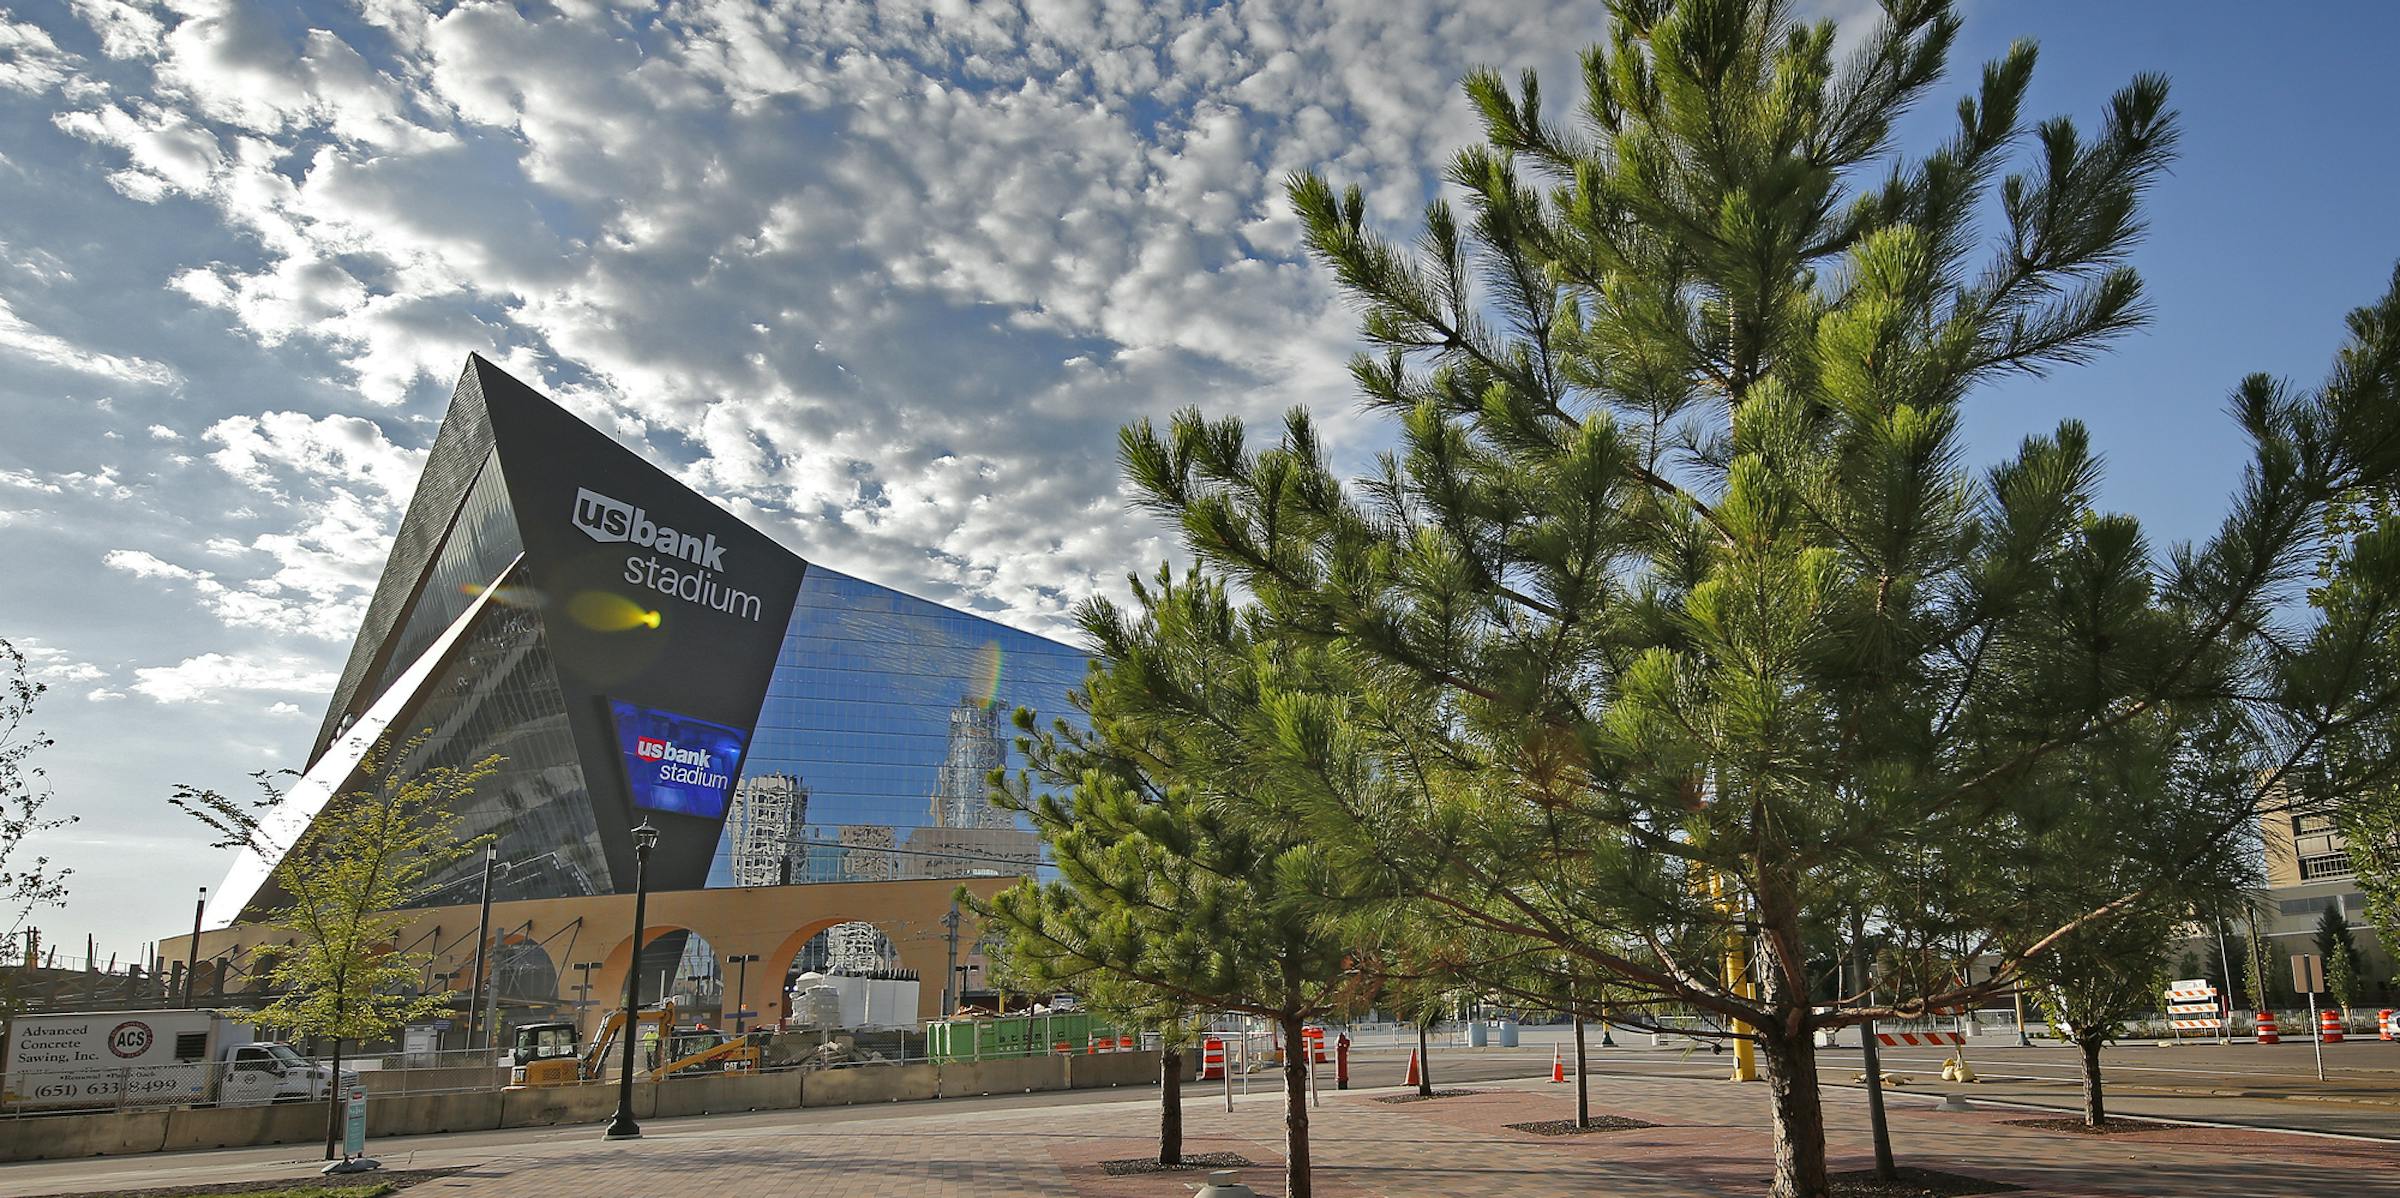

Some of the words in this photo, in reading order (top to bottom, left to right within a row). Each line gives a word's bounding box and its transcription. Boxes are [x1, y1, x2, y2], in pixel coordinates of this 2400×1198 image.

[624, 556, 762, 622] stadium
[660, 763, 728, 790] stadium
[22, 1025, 88, 1037] Advanced
[116, 1031, 145, 1048] ACS
[20, 1040, 81, 1050] Concrete
[18, 1052, 70, 1064] Sawing,
[74, 1051, 100, 1061] Inc.
[35, 1083, 78, 1099] (651)
[87, 1079, 177, 1096] 6338499
